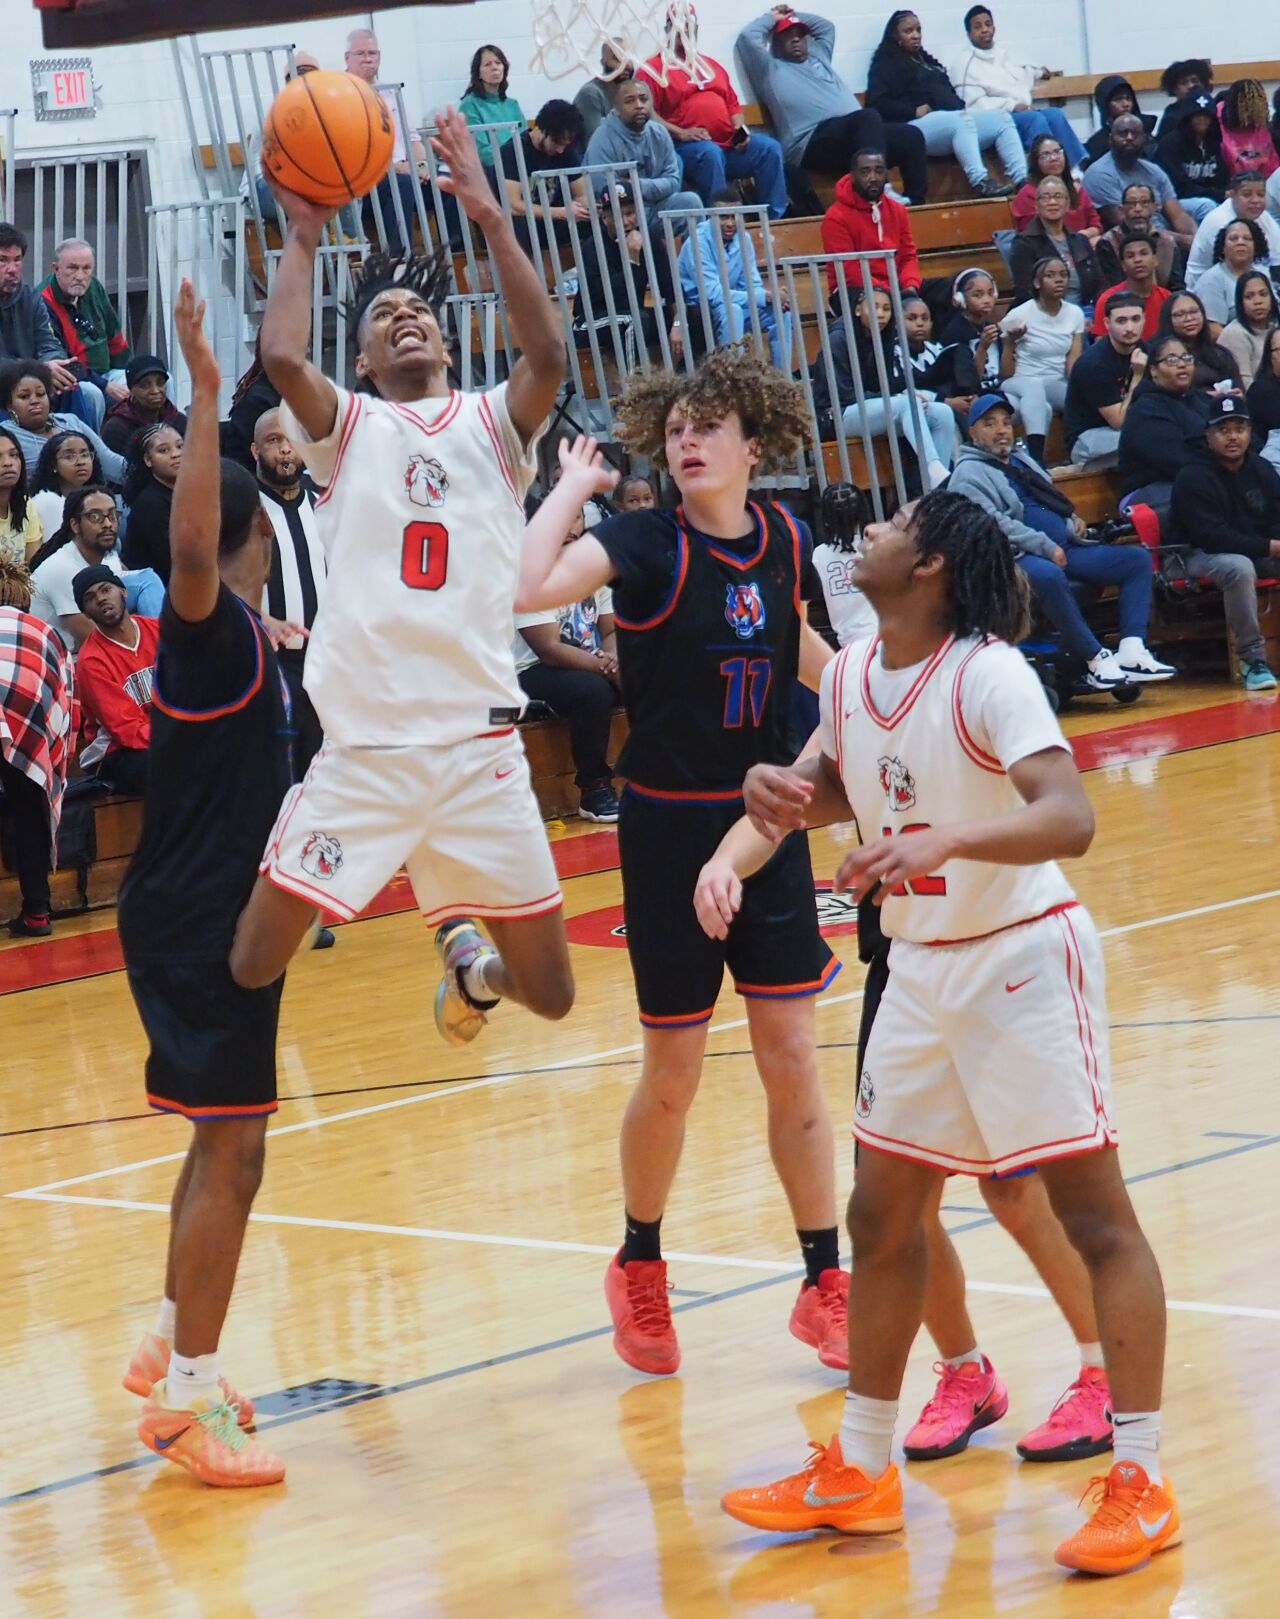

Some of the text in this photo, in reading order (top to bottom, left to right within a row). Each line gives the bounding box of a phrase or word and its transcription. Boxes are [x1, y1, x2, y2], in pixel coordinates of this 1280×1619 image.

[54, 71, 86, 105] EXIT
[400, 520, 449, 592] 0
[720, 657, 771, 728] 11
